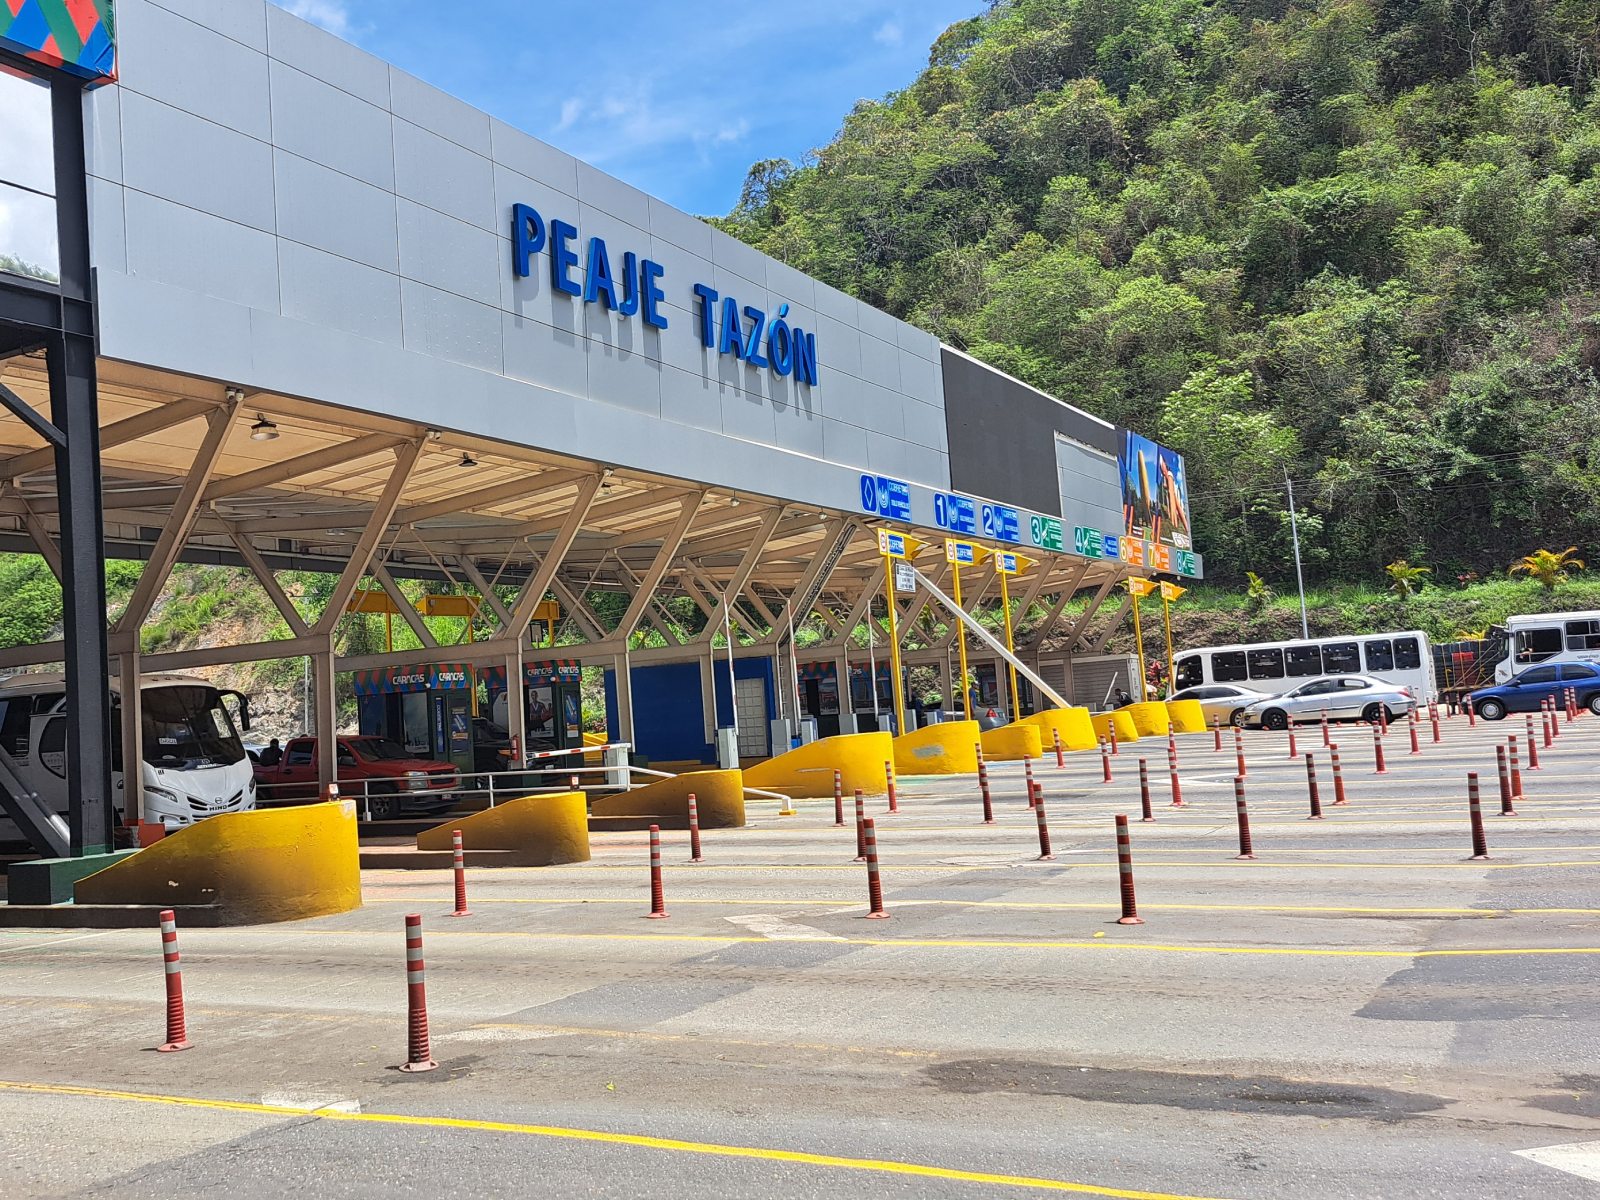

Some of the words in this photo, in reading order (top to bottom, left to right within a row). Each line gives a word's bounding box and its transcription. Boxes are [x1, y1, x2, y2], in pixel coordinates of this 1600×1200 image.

[512, 202, 668, 330] PEAJE
[693, 282, 818, 387] TAZÓN
[936, 496, 945, 526] 1
[983, 507, 994, 535] 2
[1032, 518, 1041, 544] 3
[1075, 529, 1083, 551] 4
[1120, 538, 1127, 561] 6
[1148, 544, 1155, 566] 7
